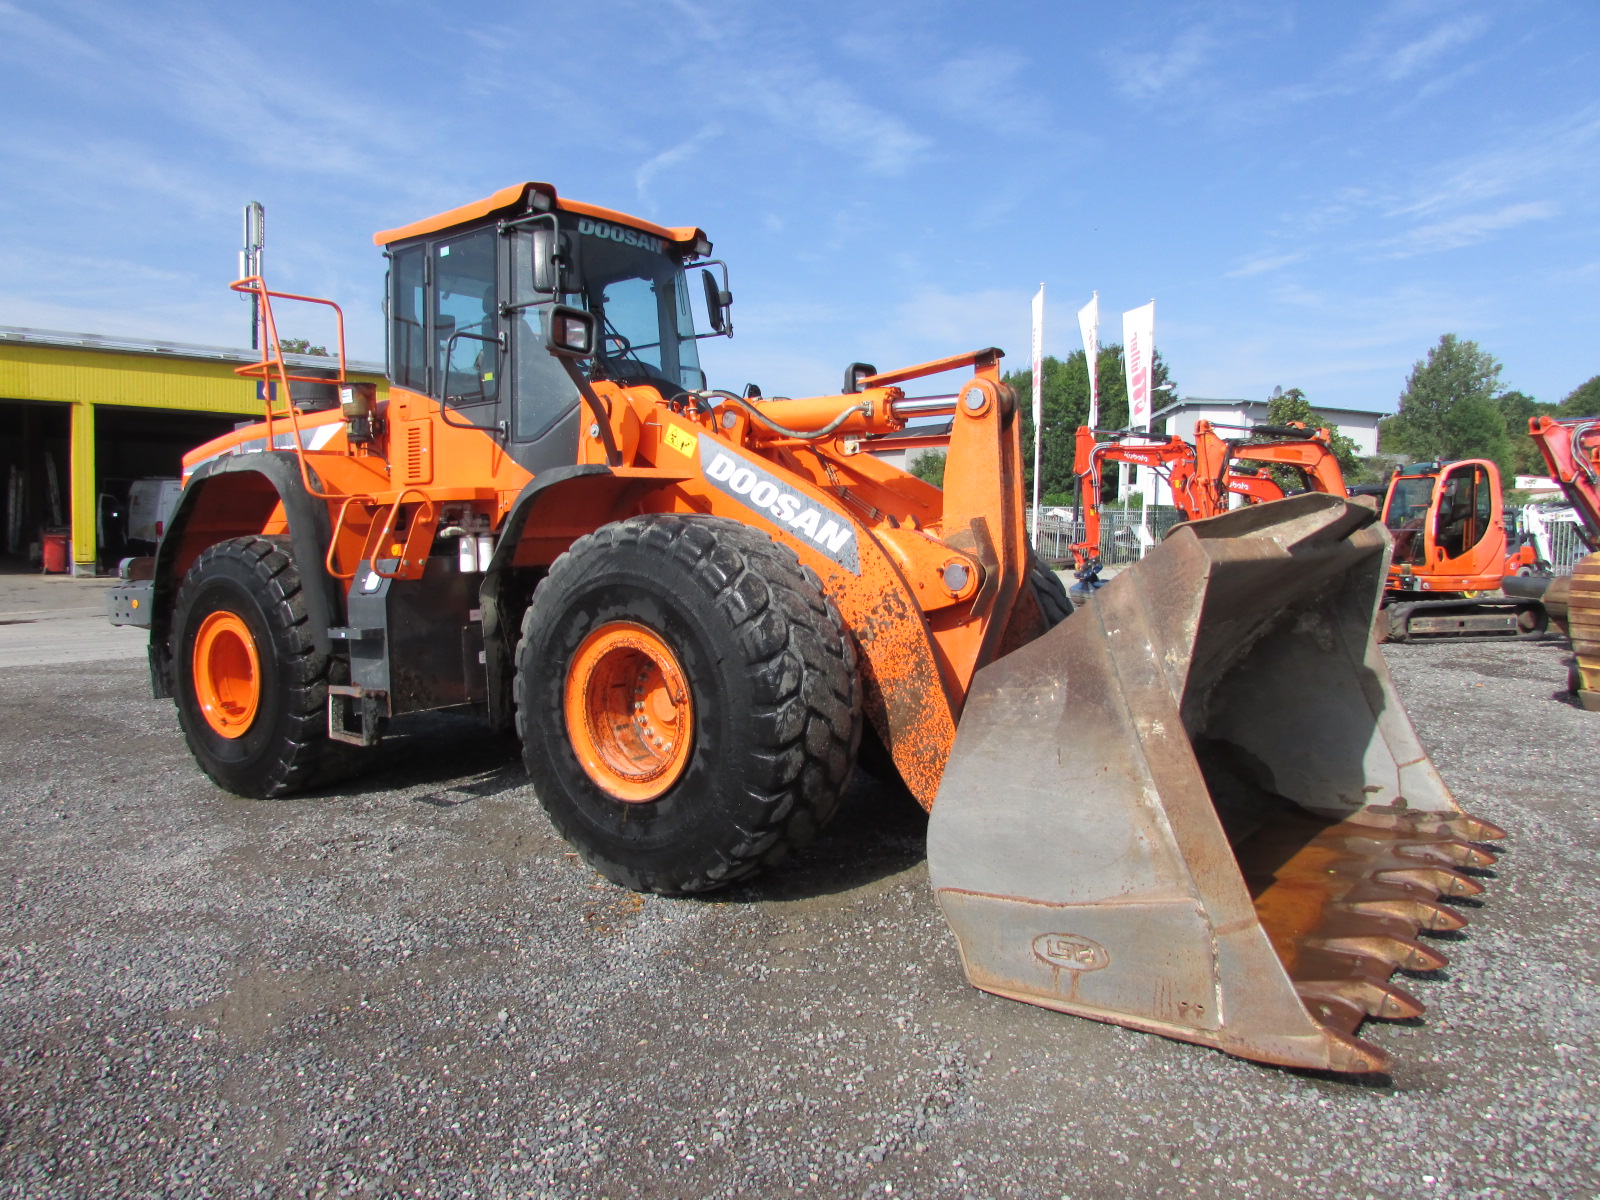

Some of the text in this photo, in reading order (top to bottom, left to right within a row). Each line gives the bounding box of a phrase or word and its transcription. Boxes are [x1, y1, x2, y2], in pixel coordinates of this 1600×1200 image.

[578, 217, 662, 255] DOOSAN
[1124, 450, 1148, 462] Kubota
[706, 452, 852, 553] DOOSAN
